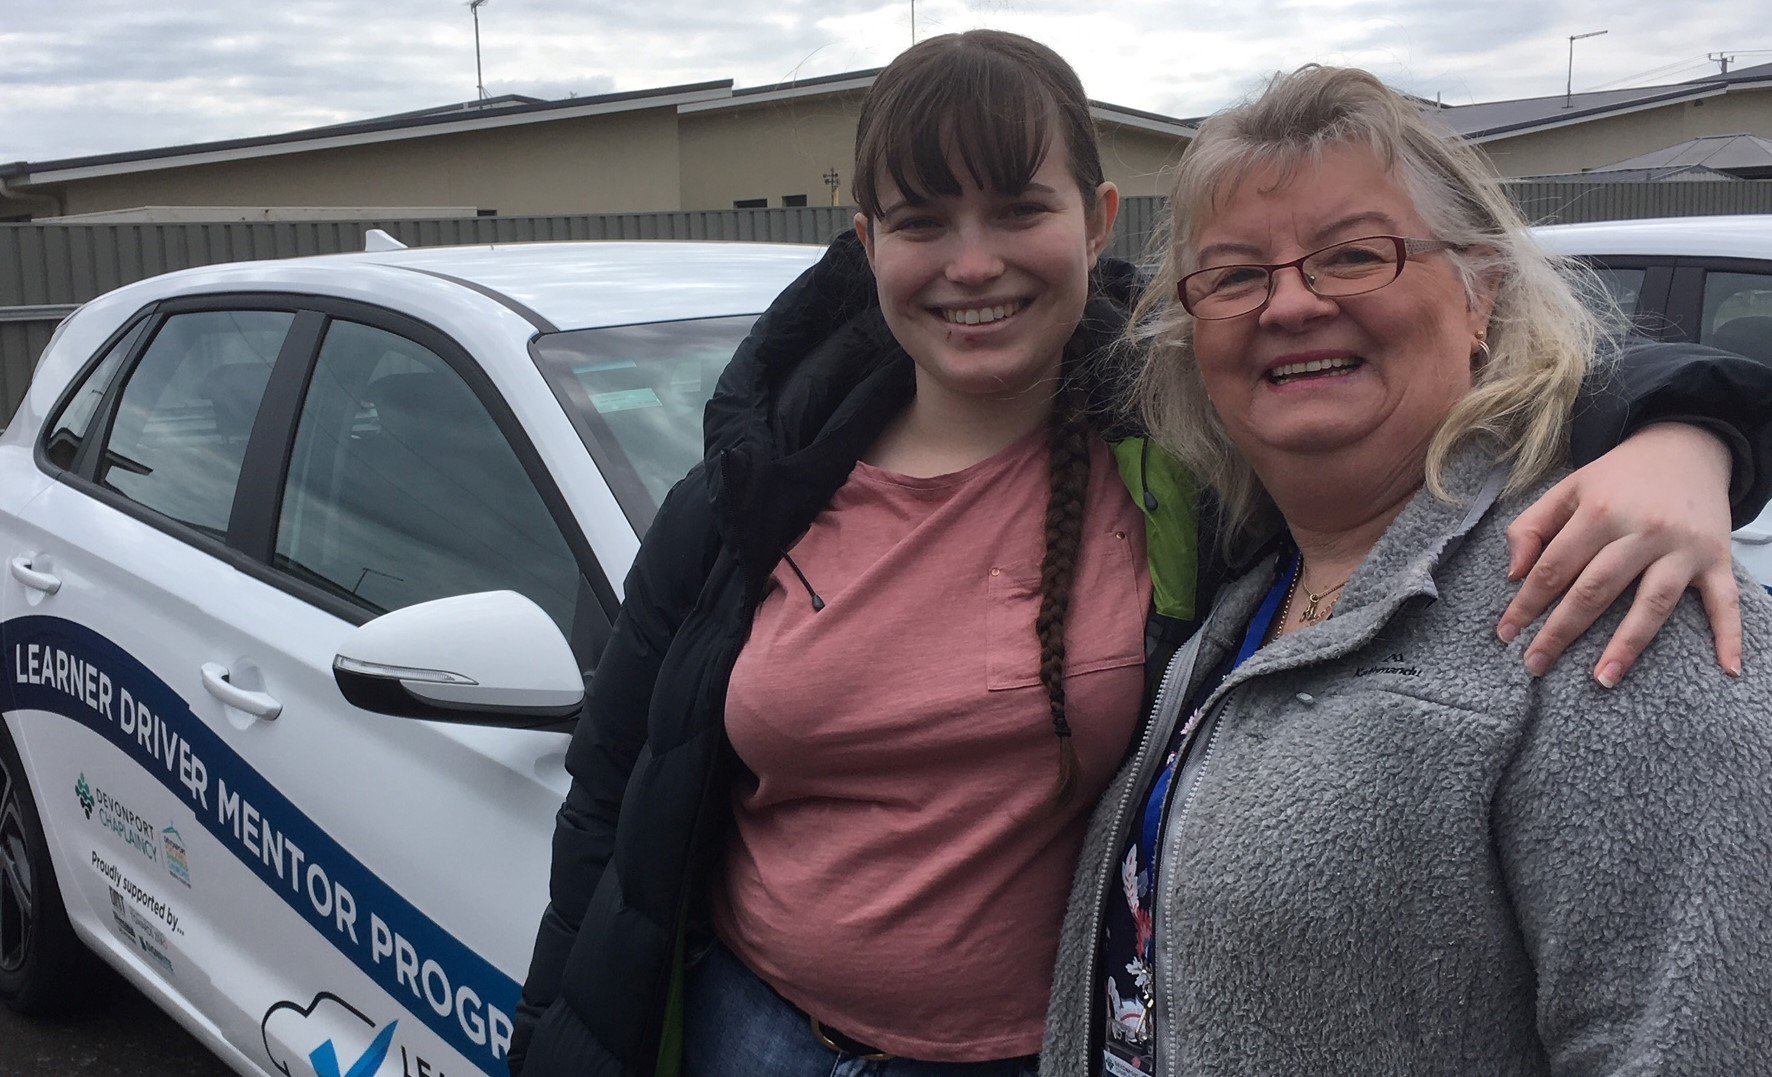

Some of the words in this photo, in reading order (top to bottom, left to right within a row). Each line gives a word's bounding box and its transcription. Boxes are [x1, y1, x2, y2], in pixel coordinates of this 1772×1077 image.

[96, 788, 154, 840] DEVONPORT
[99, 808, 157, 862] CHAPLAINCY
[15, 643, 112, 721] LEARNER
[120, 688, 209, 811] DRIVER
[218, 778, 359, 945] MENTOR
[371, 912, 514, 1060] PROGR
[92, 850, 122, 887] Proudly
[123, 878, 166, 919] supported
